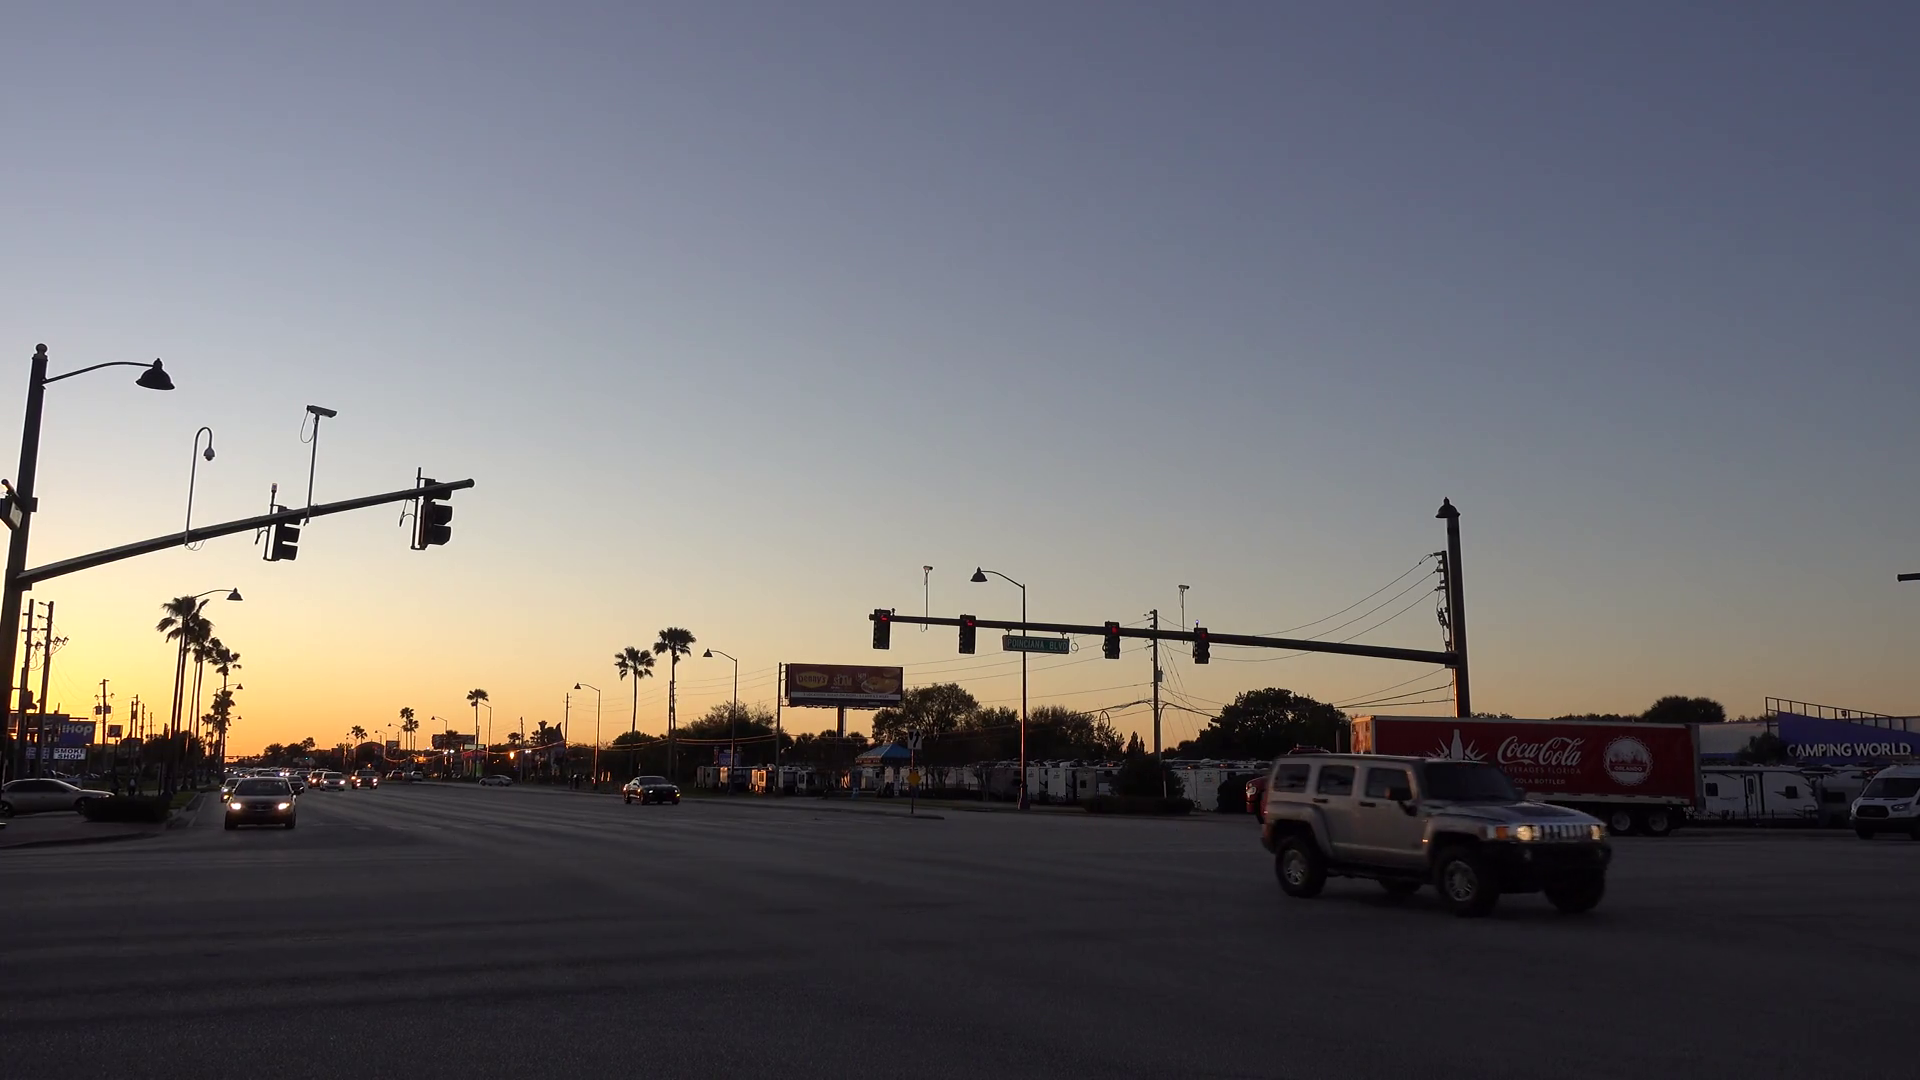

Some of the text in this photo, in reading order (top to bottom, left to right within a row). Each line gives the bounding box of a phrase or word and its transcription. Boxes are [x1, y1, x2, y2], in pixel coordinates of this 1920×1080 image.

[1007, 638, 1067, 650] POINCIANA BLVD
[1497, 735, 1587, 766] Coca-Cola
[1786, 742, 1912, 757] CAMPING WORLD
[1499, 766, 1582, 775] EVERAGES FLORIDA
